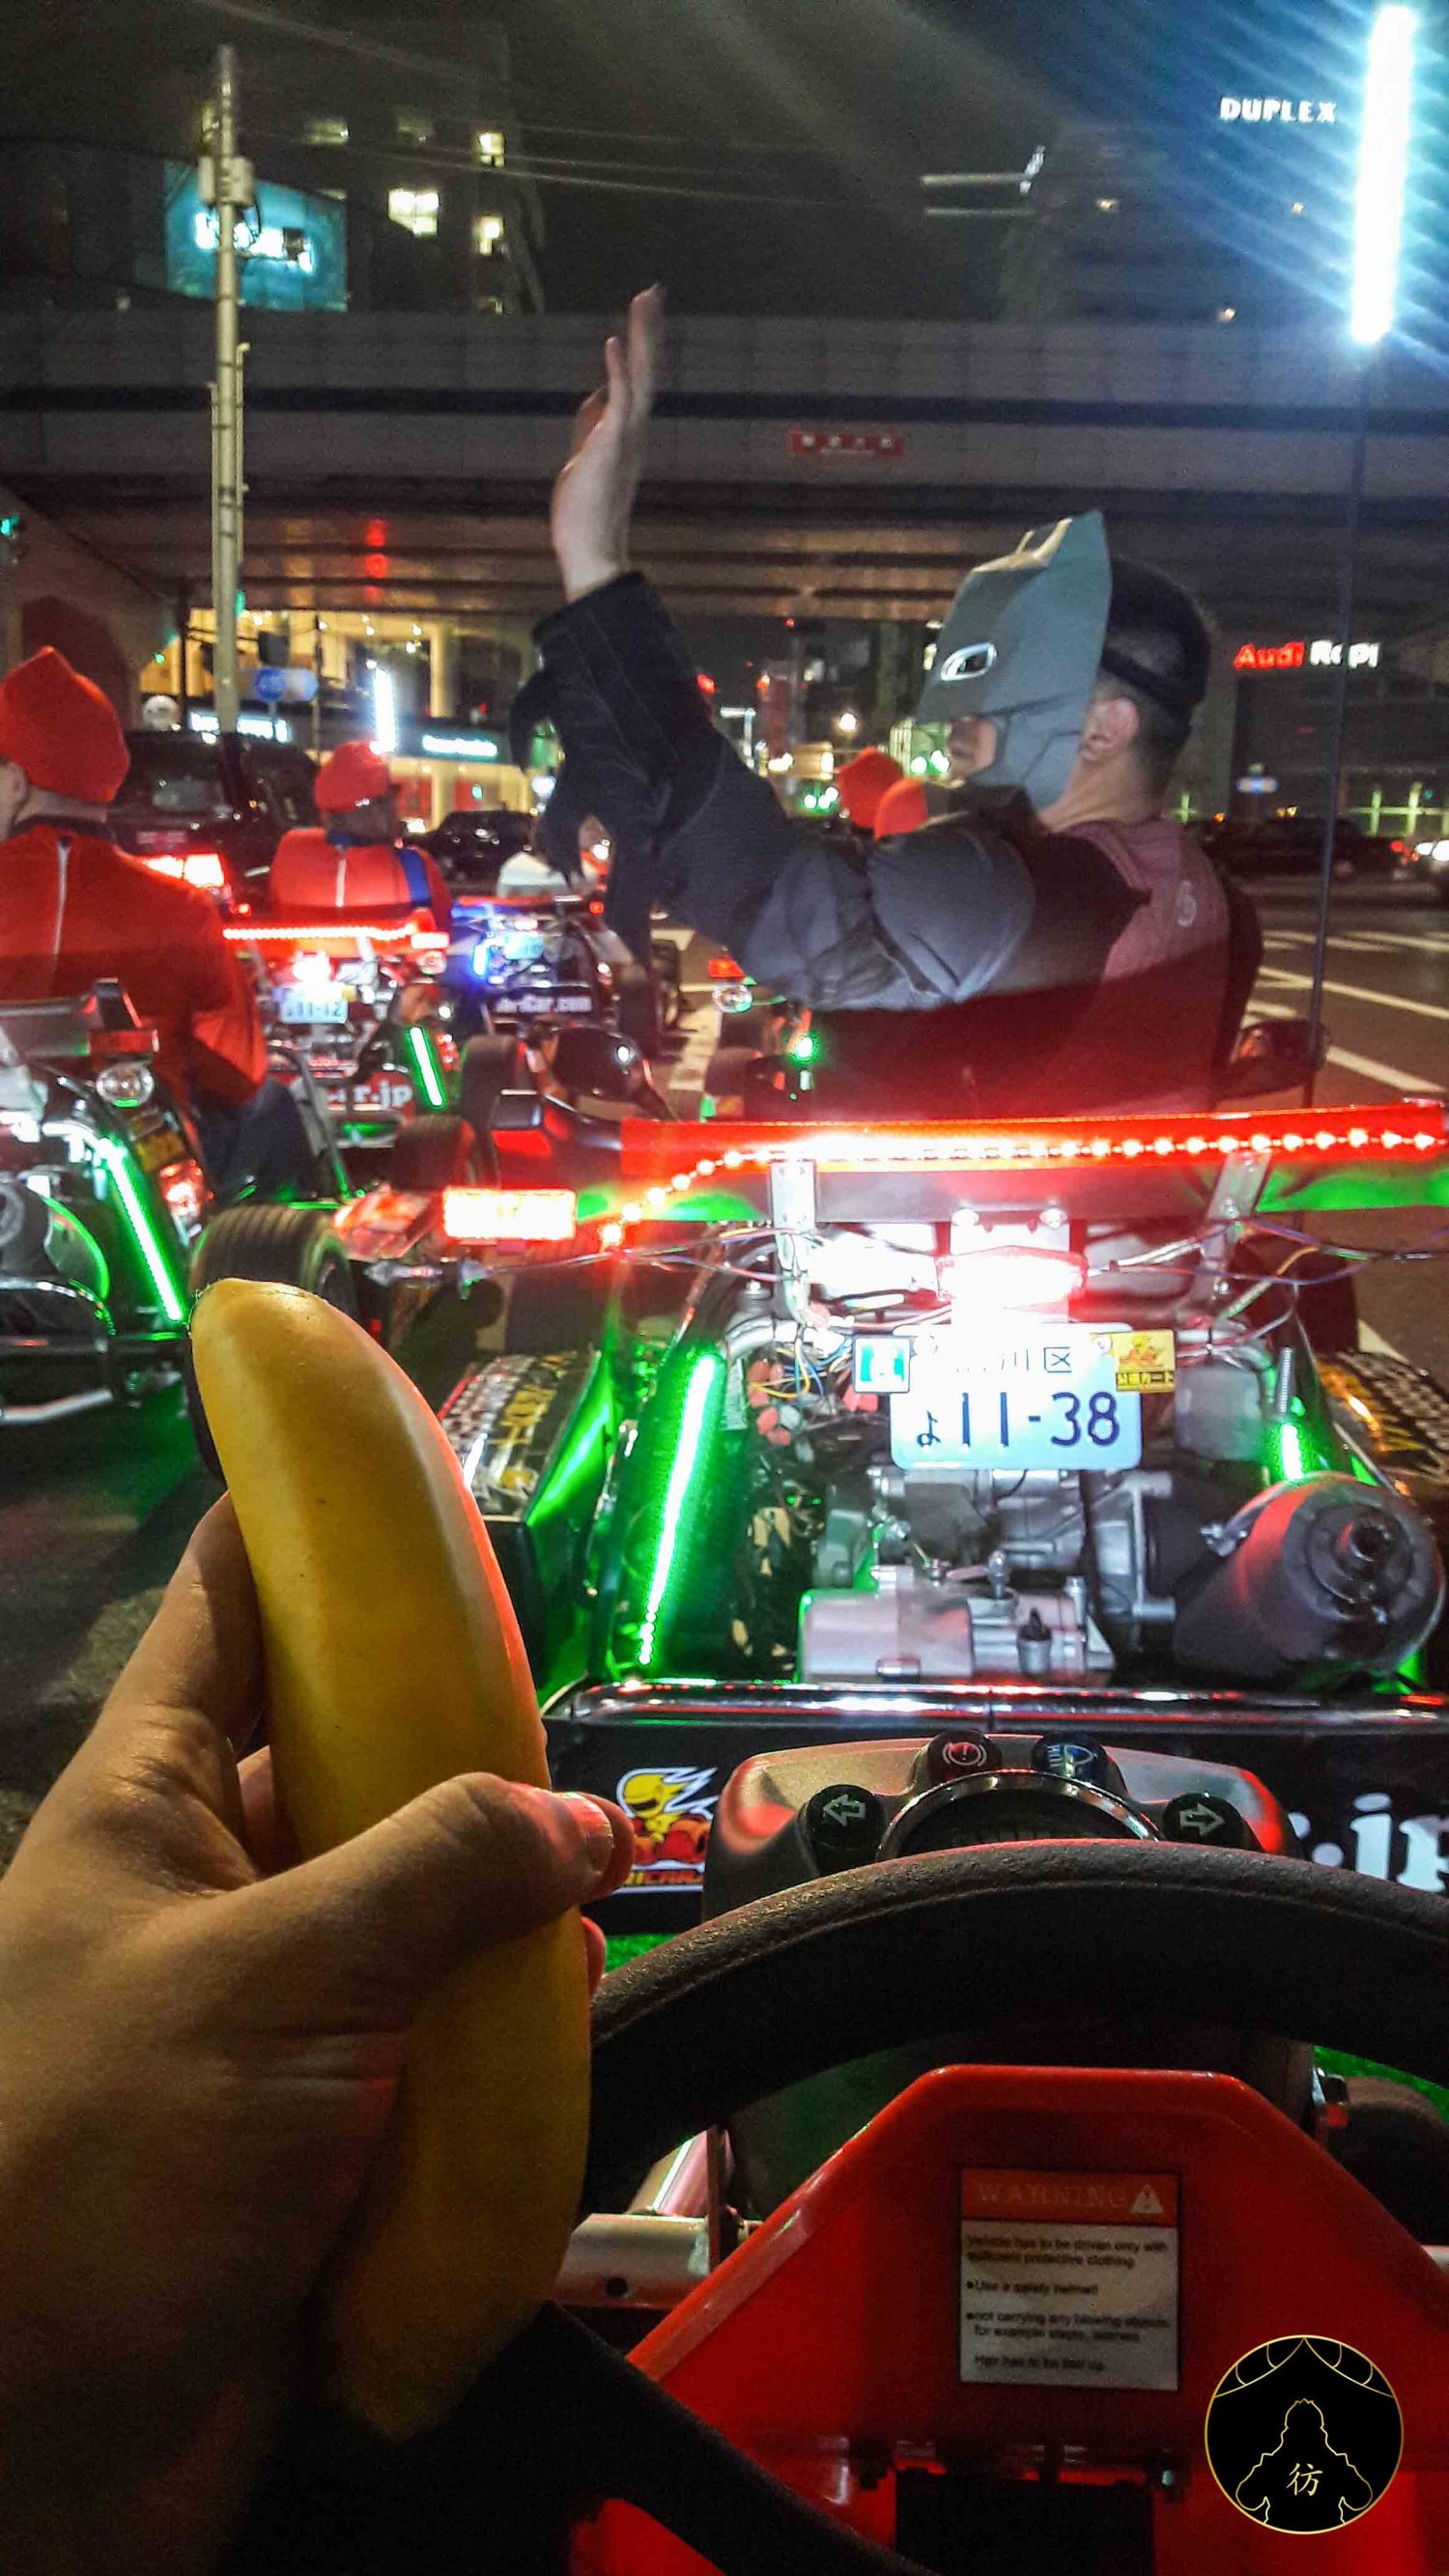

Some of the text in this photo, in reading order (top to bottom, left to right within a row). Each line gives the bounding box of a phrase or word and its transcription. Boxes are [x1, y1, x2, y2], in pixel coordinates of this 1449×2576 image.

[1219, 97, 1337, 123] DUPLEX
[1234, 641, 1305, 669] Audi
[962, 1391, 1121, 1447] 11-38
[979, 2183, 1125, 2209] WARNING
[1039, 2238, 1053, 2249] to
[1055, 2239, 1070, 2250] be
[1073, 2240, 1112, 2250] driven
[1115, 2241, 1140, 2253] only
[1143, 2241, 1168, 2252] with
[1024, 2252, 1083, 2265] protective
[1087, 2254, 1135, 2269] clothing
[997, 2313, 1045, 2327] carrying
